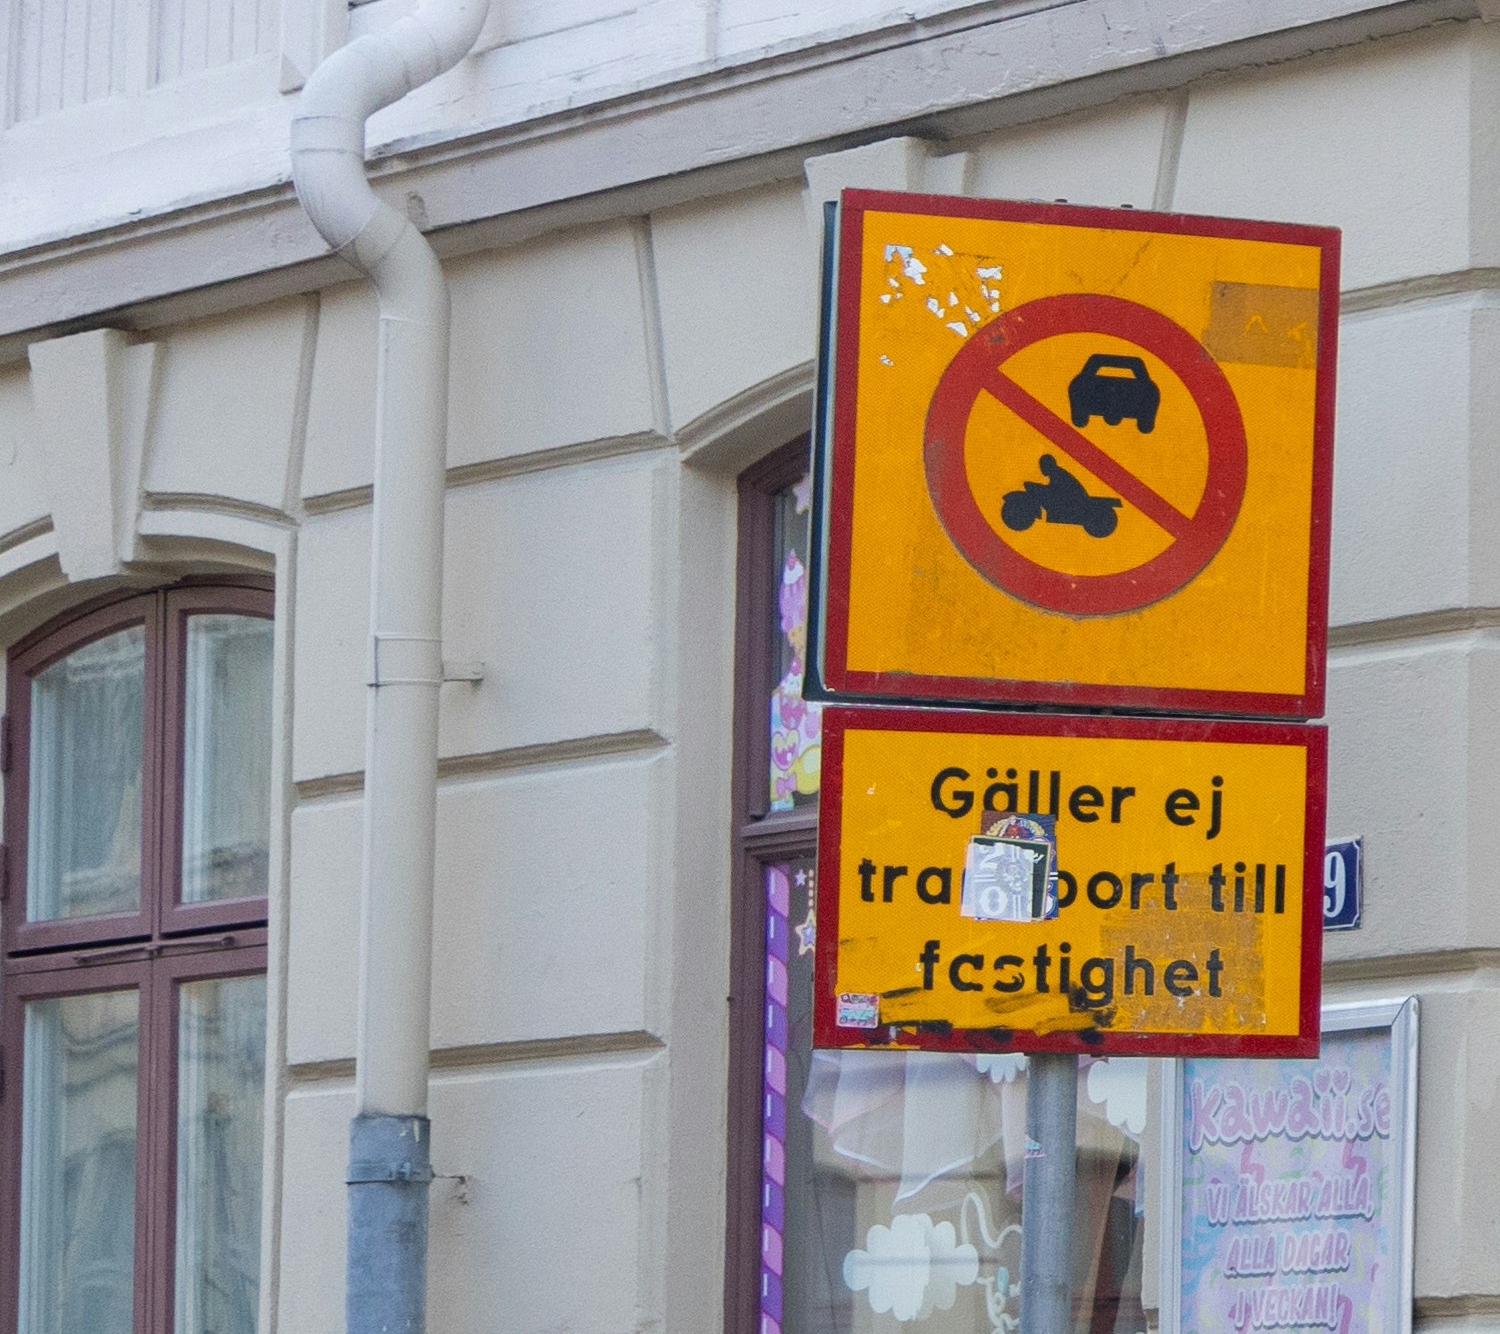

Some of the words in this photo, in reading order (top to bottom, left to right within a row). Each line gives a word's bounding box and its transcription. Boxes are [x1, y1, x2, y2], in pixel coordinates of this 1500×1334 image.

[930, 767, 1136, 824] Gäller
[1164, 775, 1224, 840] ej
[858, 857, 1180, 912] traort
[1208, 860, 1287, 914] till
[1323, 851, 1346, 917] 9
[919, 939, 1224, 1008] fastighet
[1188, 1068, 1391, 1155] kawaii.se
[1206, 1184, 1229, 1227] VI
[1232, 1174, 1312, 1225] ÄLSKAR
[1314, 1175, 1375, 1222] ALLA,
[1224, 1236, 1277, 1279] ALLA
[1281, 1232, 1350, 1275] DAGAR
[1252, 1283, 1339, 1331] VECKAN!
